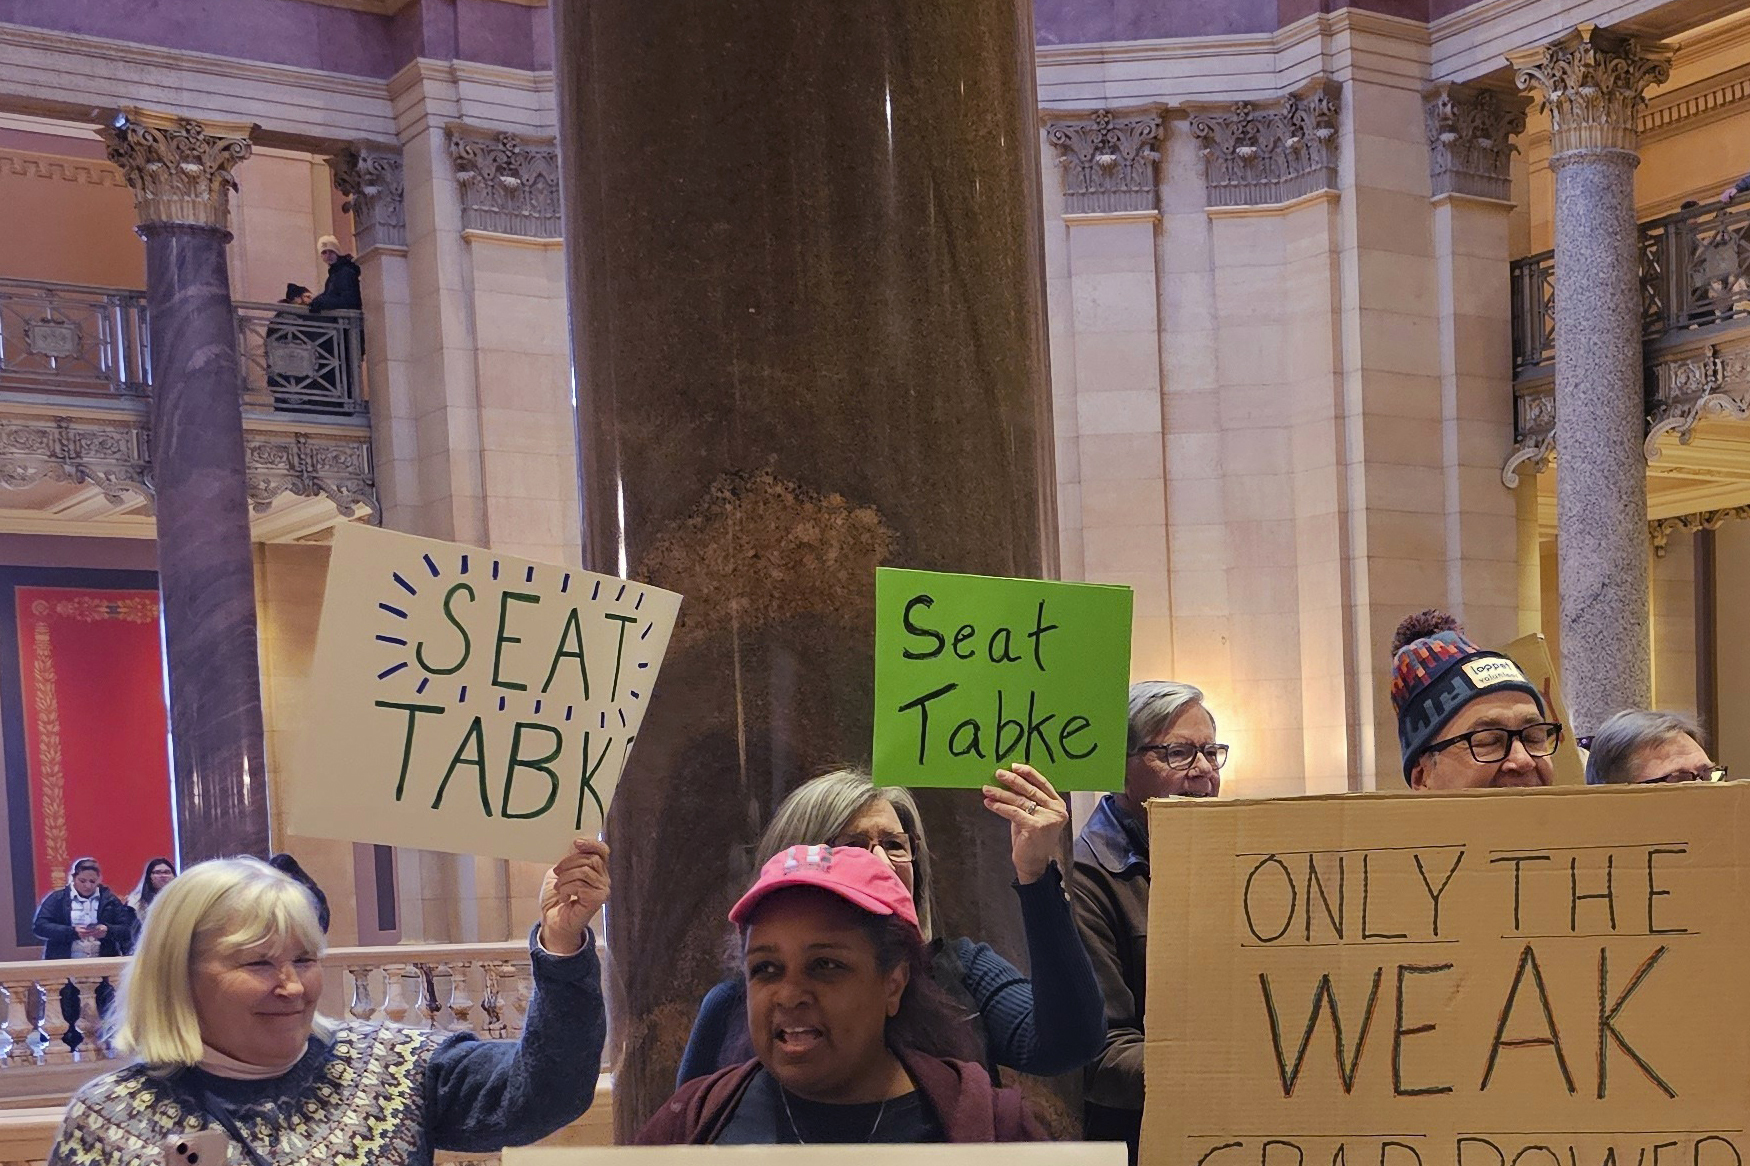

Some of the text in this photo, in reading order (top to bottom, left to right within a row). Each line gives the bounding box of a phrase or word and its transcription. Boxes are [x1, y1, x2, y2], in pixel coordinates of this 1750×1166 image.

[415, 582, 638, 703] SEAT
[902, 594, 1059, 672] Seat
[898, 682, 1099, 766] Tabke
[1243, 850, 1467, 943] ONLY
[1490, 848, 1689, 934] THE
[1258, 942, 1679, 1099] WEAK
